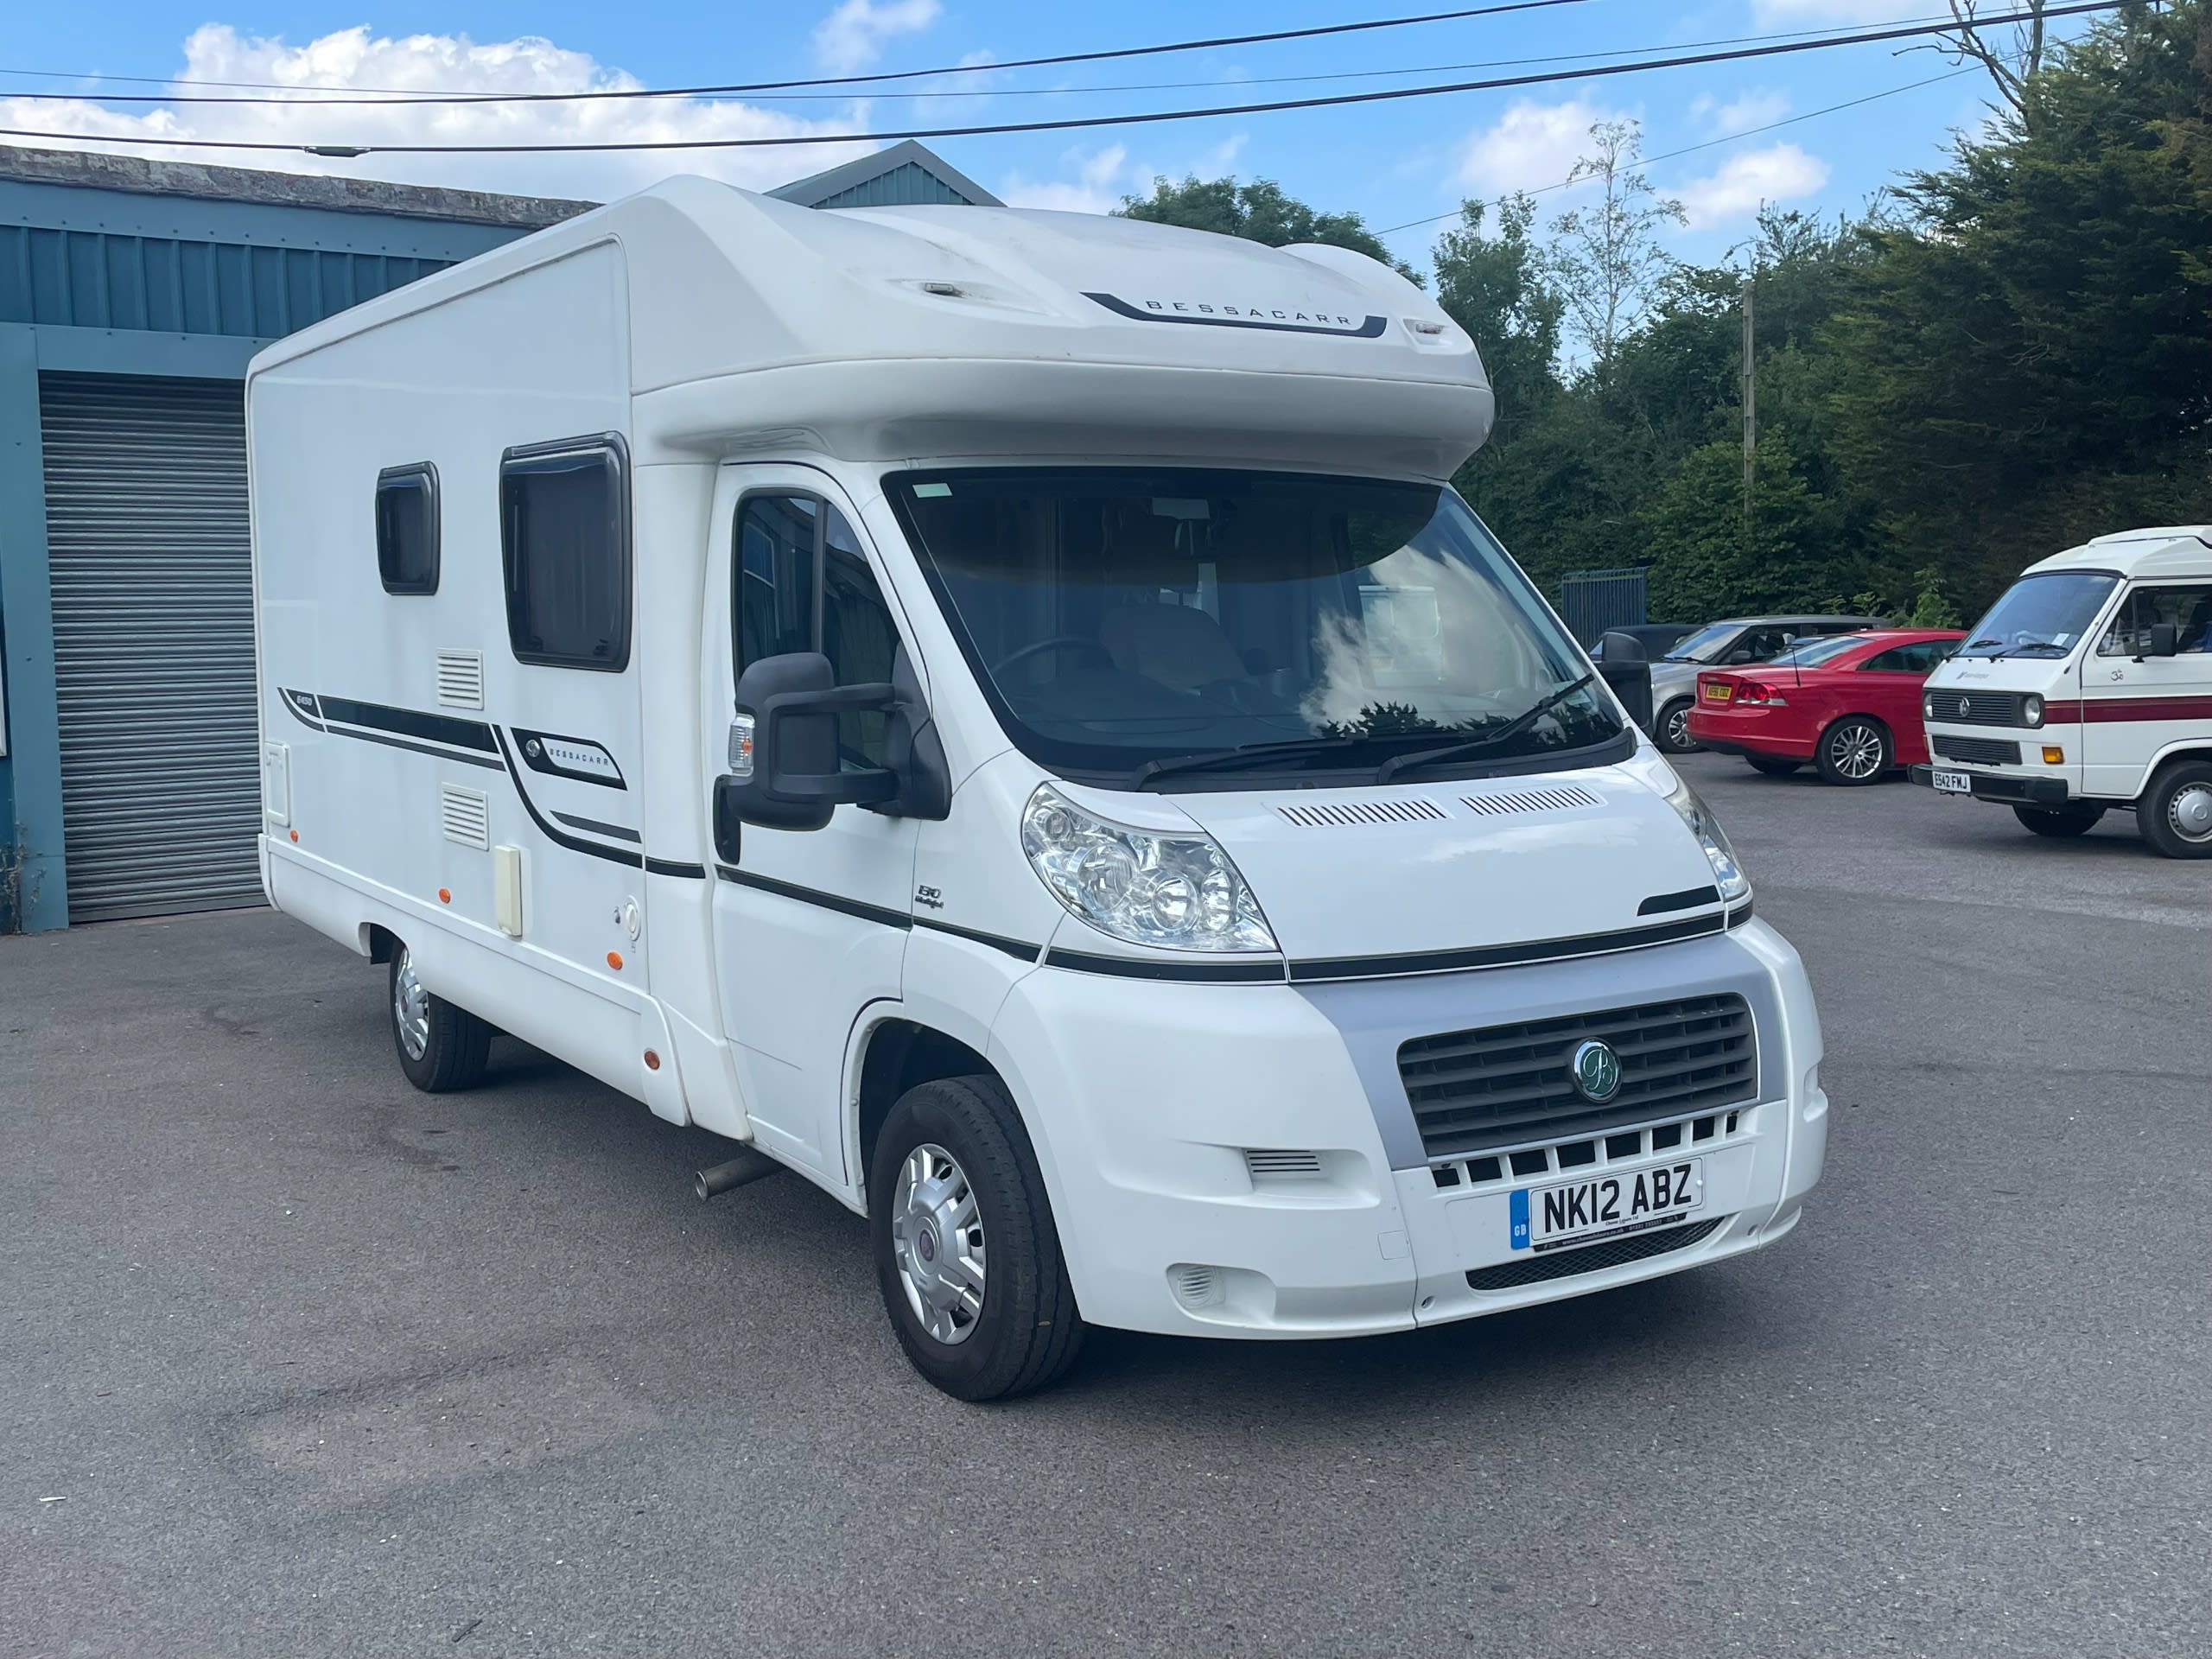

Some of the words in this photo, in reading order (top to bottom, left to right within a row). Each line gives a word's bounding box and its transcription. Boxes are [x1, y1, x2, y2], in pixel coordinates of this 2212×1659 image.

[1145, 301, 1351, 326] BESSACARR
[549, 747, 609, 766] BESSACARR
[1934, 772, 1950, 788] E542
[1951, 774, 1967, 790] FMJ
[1543, 1179, 1620, 1234] NK12
[1630, 1163, 1692, 1216] ABZ
[1514, 1224, 1527, 1236] GB
